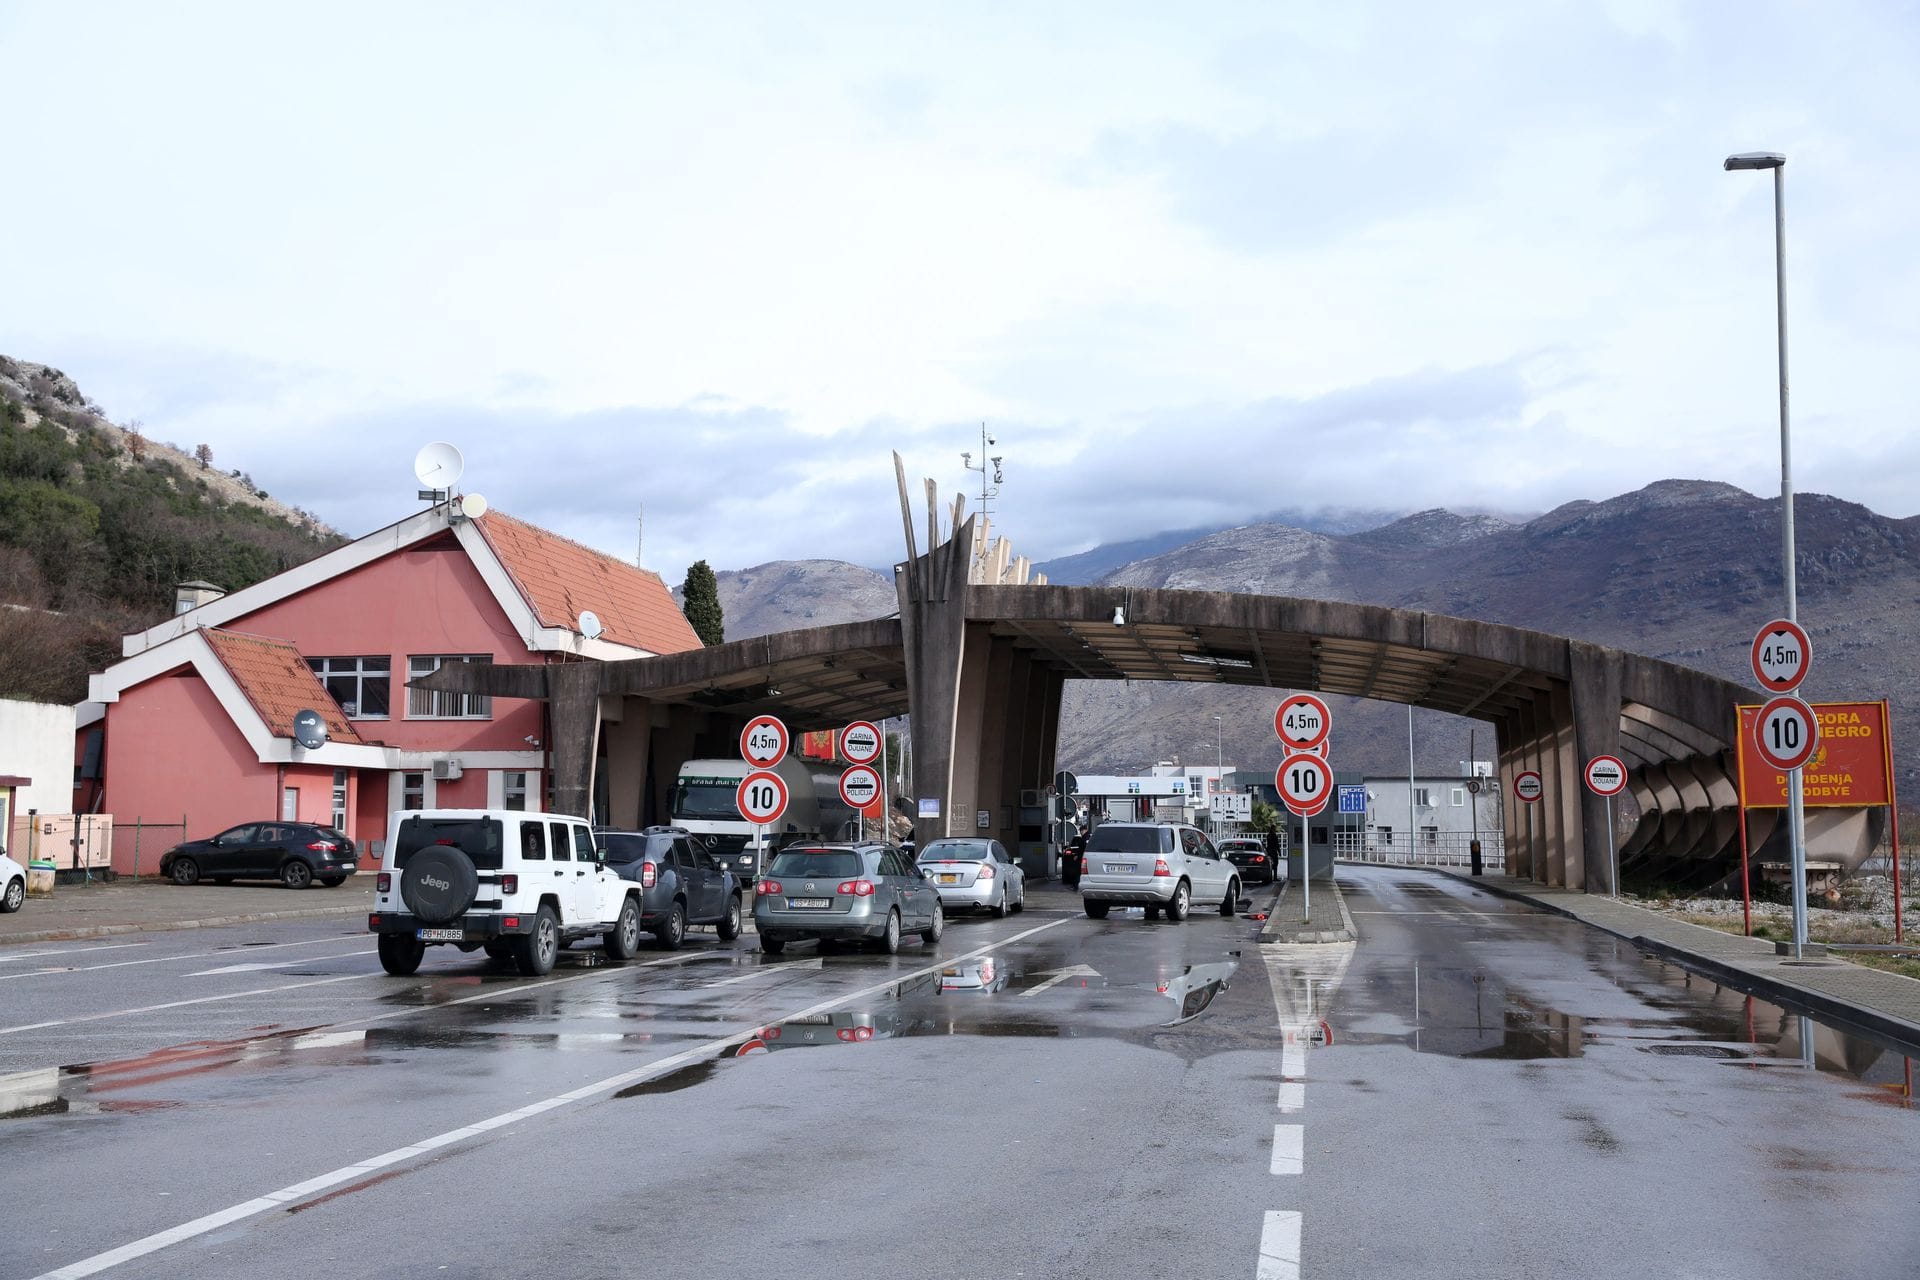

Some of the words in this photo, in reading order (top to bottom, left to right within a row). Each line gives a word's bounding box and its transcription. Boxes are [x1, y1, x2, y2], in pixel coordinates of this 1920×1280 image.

[1763, 646, 1798, 667] 4,5m
[1285, 714, 1319, 730] 4,5m
[849, 732, 873, 740] CARINA
[1771, 717, 1799, 749] 10
[750, 734, 778, 749] 4,5m
[852, 776, 868, 784] STOP
[1291, 769, 1316, 793] 10
[1592, 777, 1618, 785] DOUANE
[751, 785, 774, 809] 10
[1781, 786, 1851, 797] GODBYE
[420, 874, 450, 891] Jeep
[422, 930, 433, 938] PG
[436, 930, 462, 939] HU885
